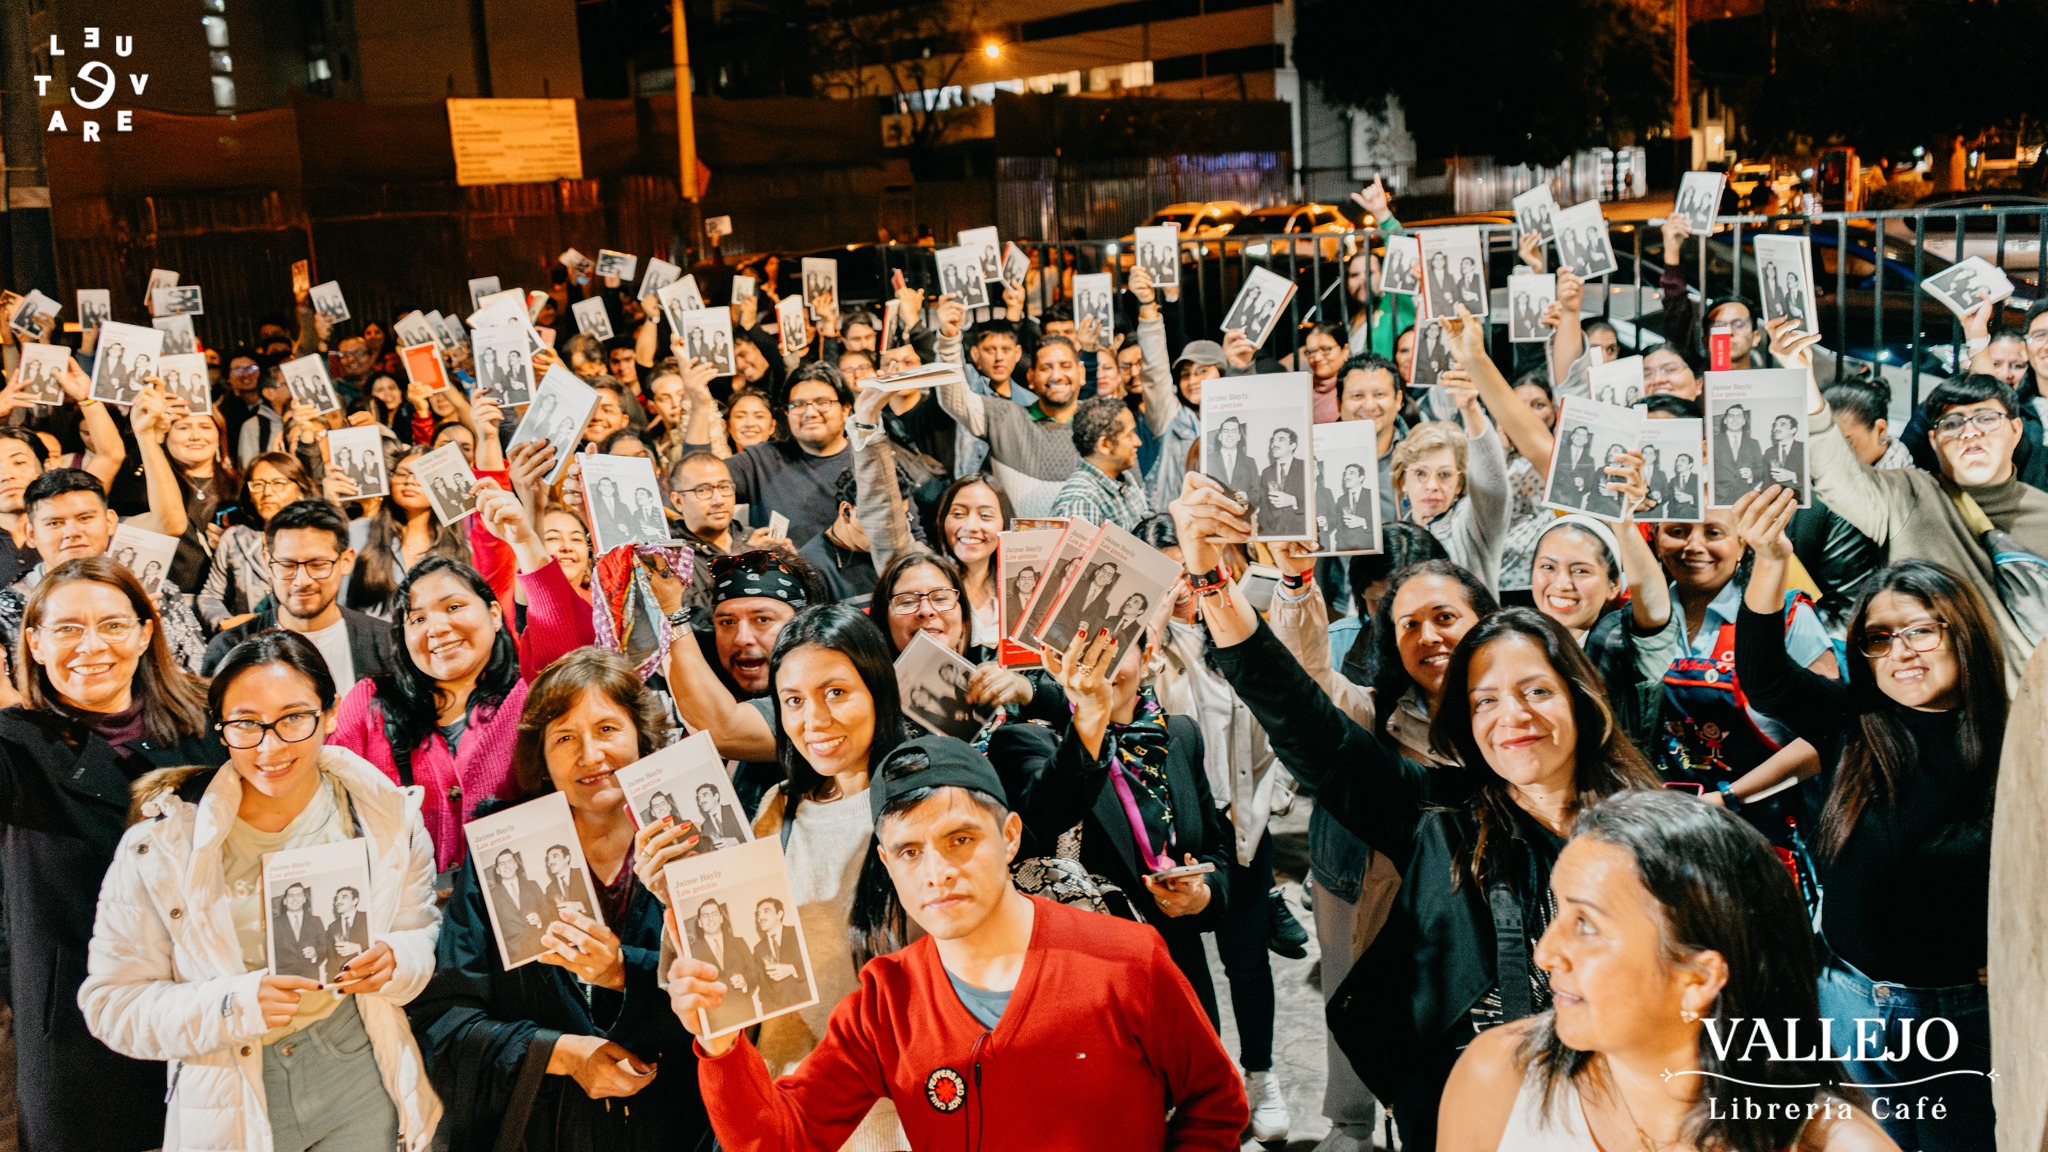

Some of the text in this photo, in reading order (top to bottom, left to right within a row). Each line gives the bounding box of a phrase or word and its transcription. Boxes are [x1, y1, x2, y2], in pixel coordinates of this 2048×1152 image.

[1229, 392, 1249, 401] Bayly
[1220, 402, 1243, 410] genios
[1069, 535, 1079, 544] Los
[1071, 530, 1088, 541] Jaime
[1100, 541, 1128, 561] Los genios
[1104, 535, 1137, 558] Jaime Bayly
[628, 768, 664, 788] Jaime Bayly
[630, 778, 662, 795] Los genios
[475, 824, 515, 843] Jaime Bayly
[476, 834, 513, 851] Los genios
[291, 860, 312, 868] Bayly
[269, 869, 306, 880] Los genios
[675, 870, 722, 889] Jaime Bayly
[676, 881, 718, 897] Los genios
